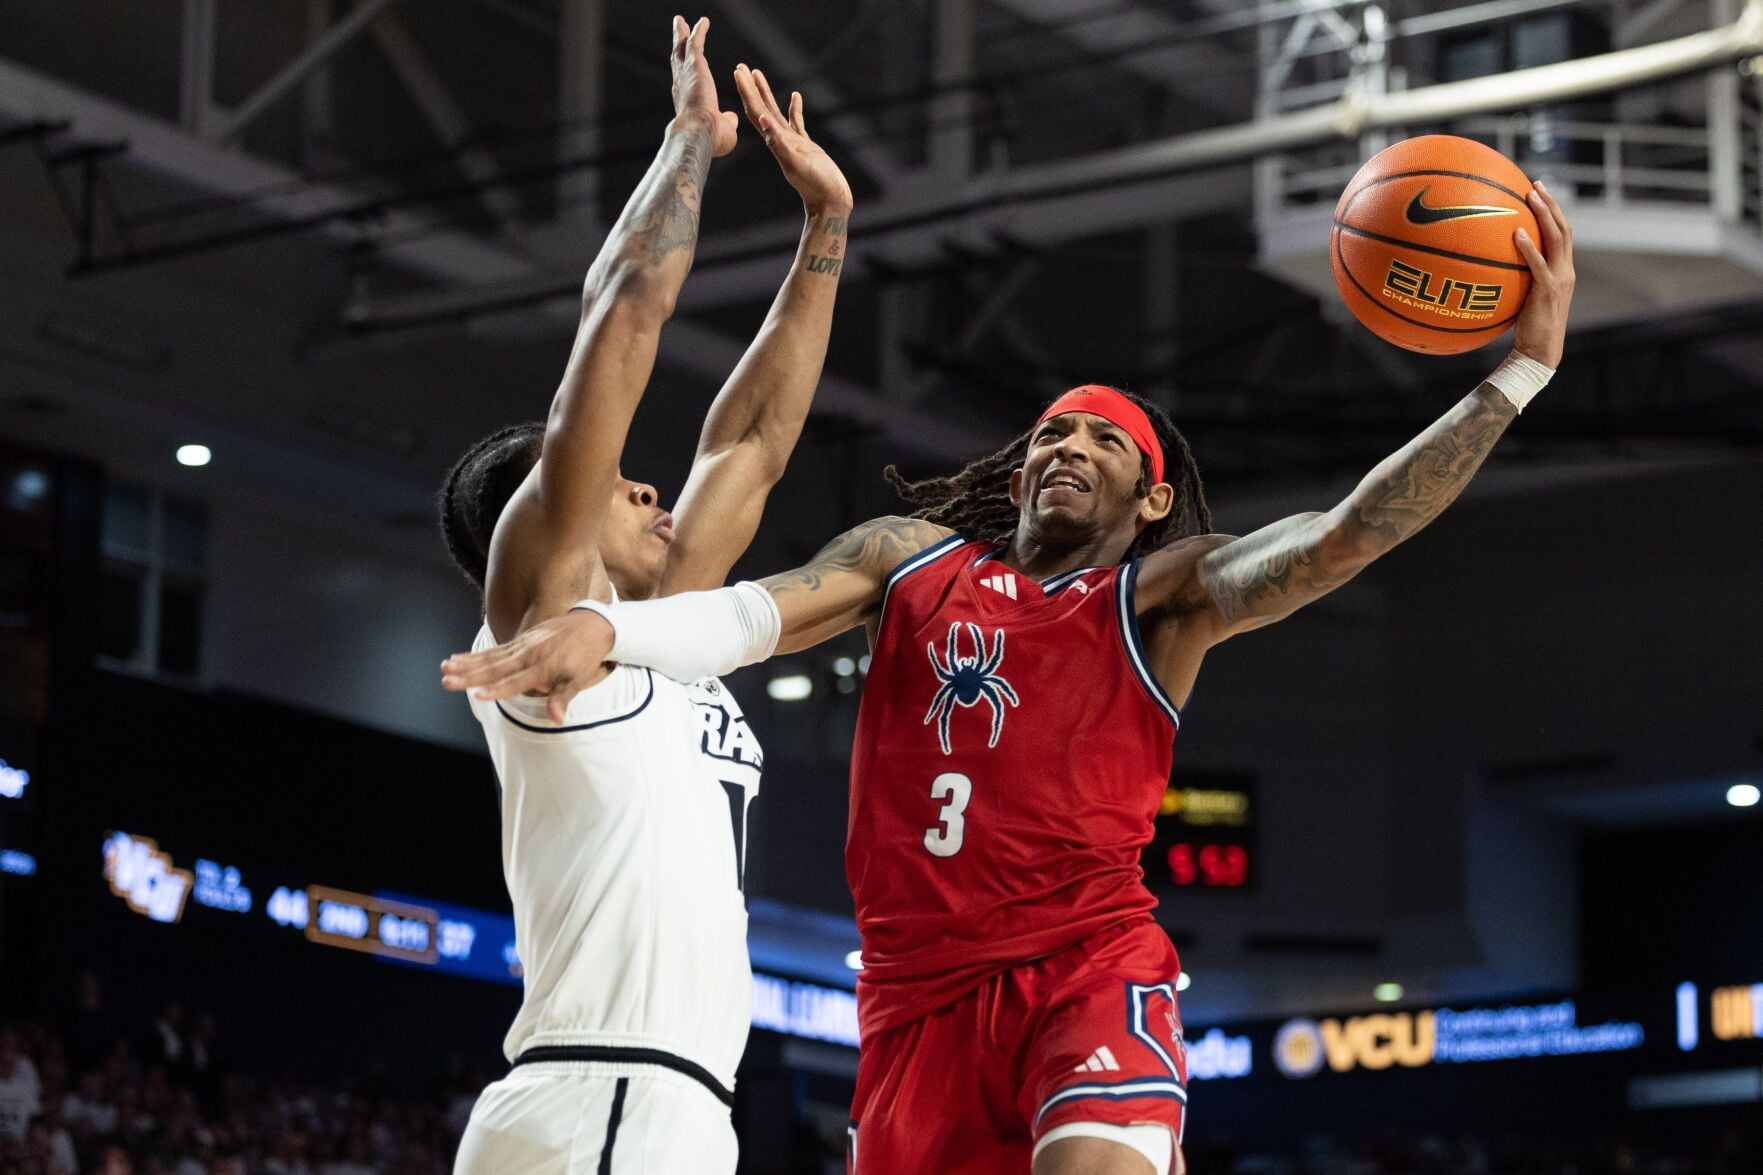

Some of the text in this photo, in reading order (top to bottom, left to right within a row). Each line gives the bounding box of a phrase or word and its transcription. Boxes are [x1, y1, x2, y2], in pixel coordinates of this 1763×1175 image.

[1382, 288, 1495, 320] CHAMPIONSHIP
[1384, 258, 1504, 312] ELITE
[690, 703, 765, 772] RA
[923, 771, 973, 858] 3
[1320, 1009, 1436, 1072] VCU
